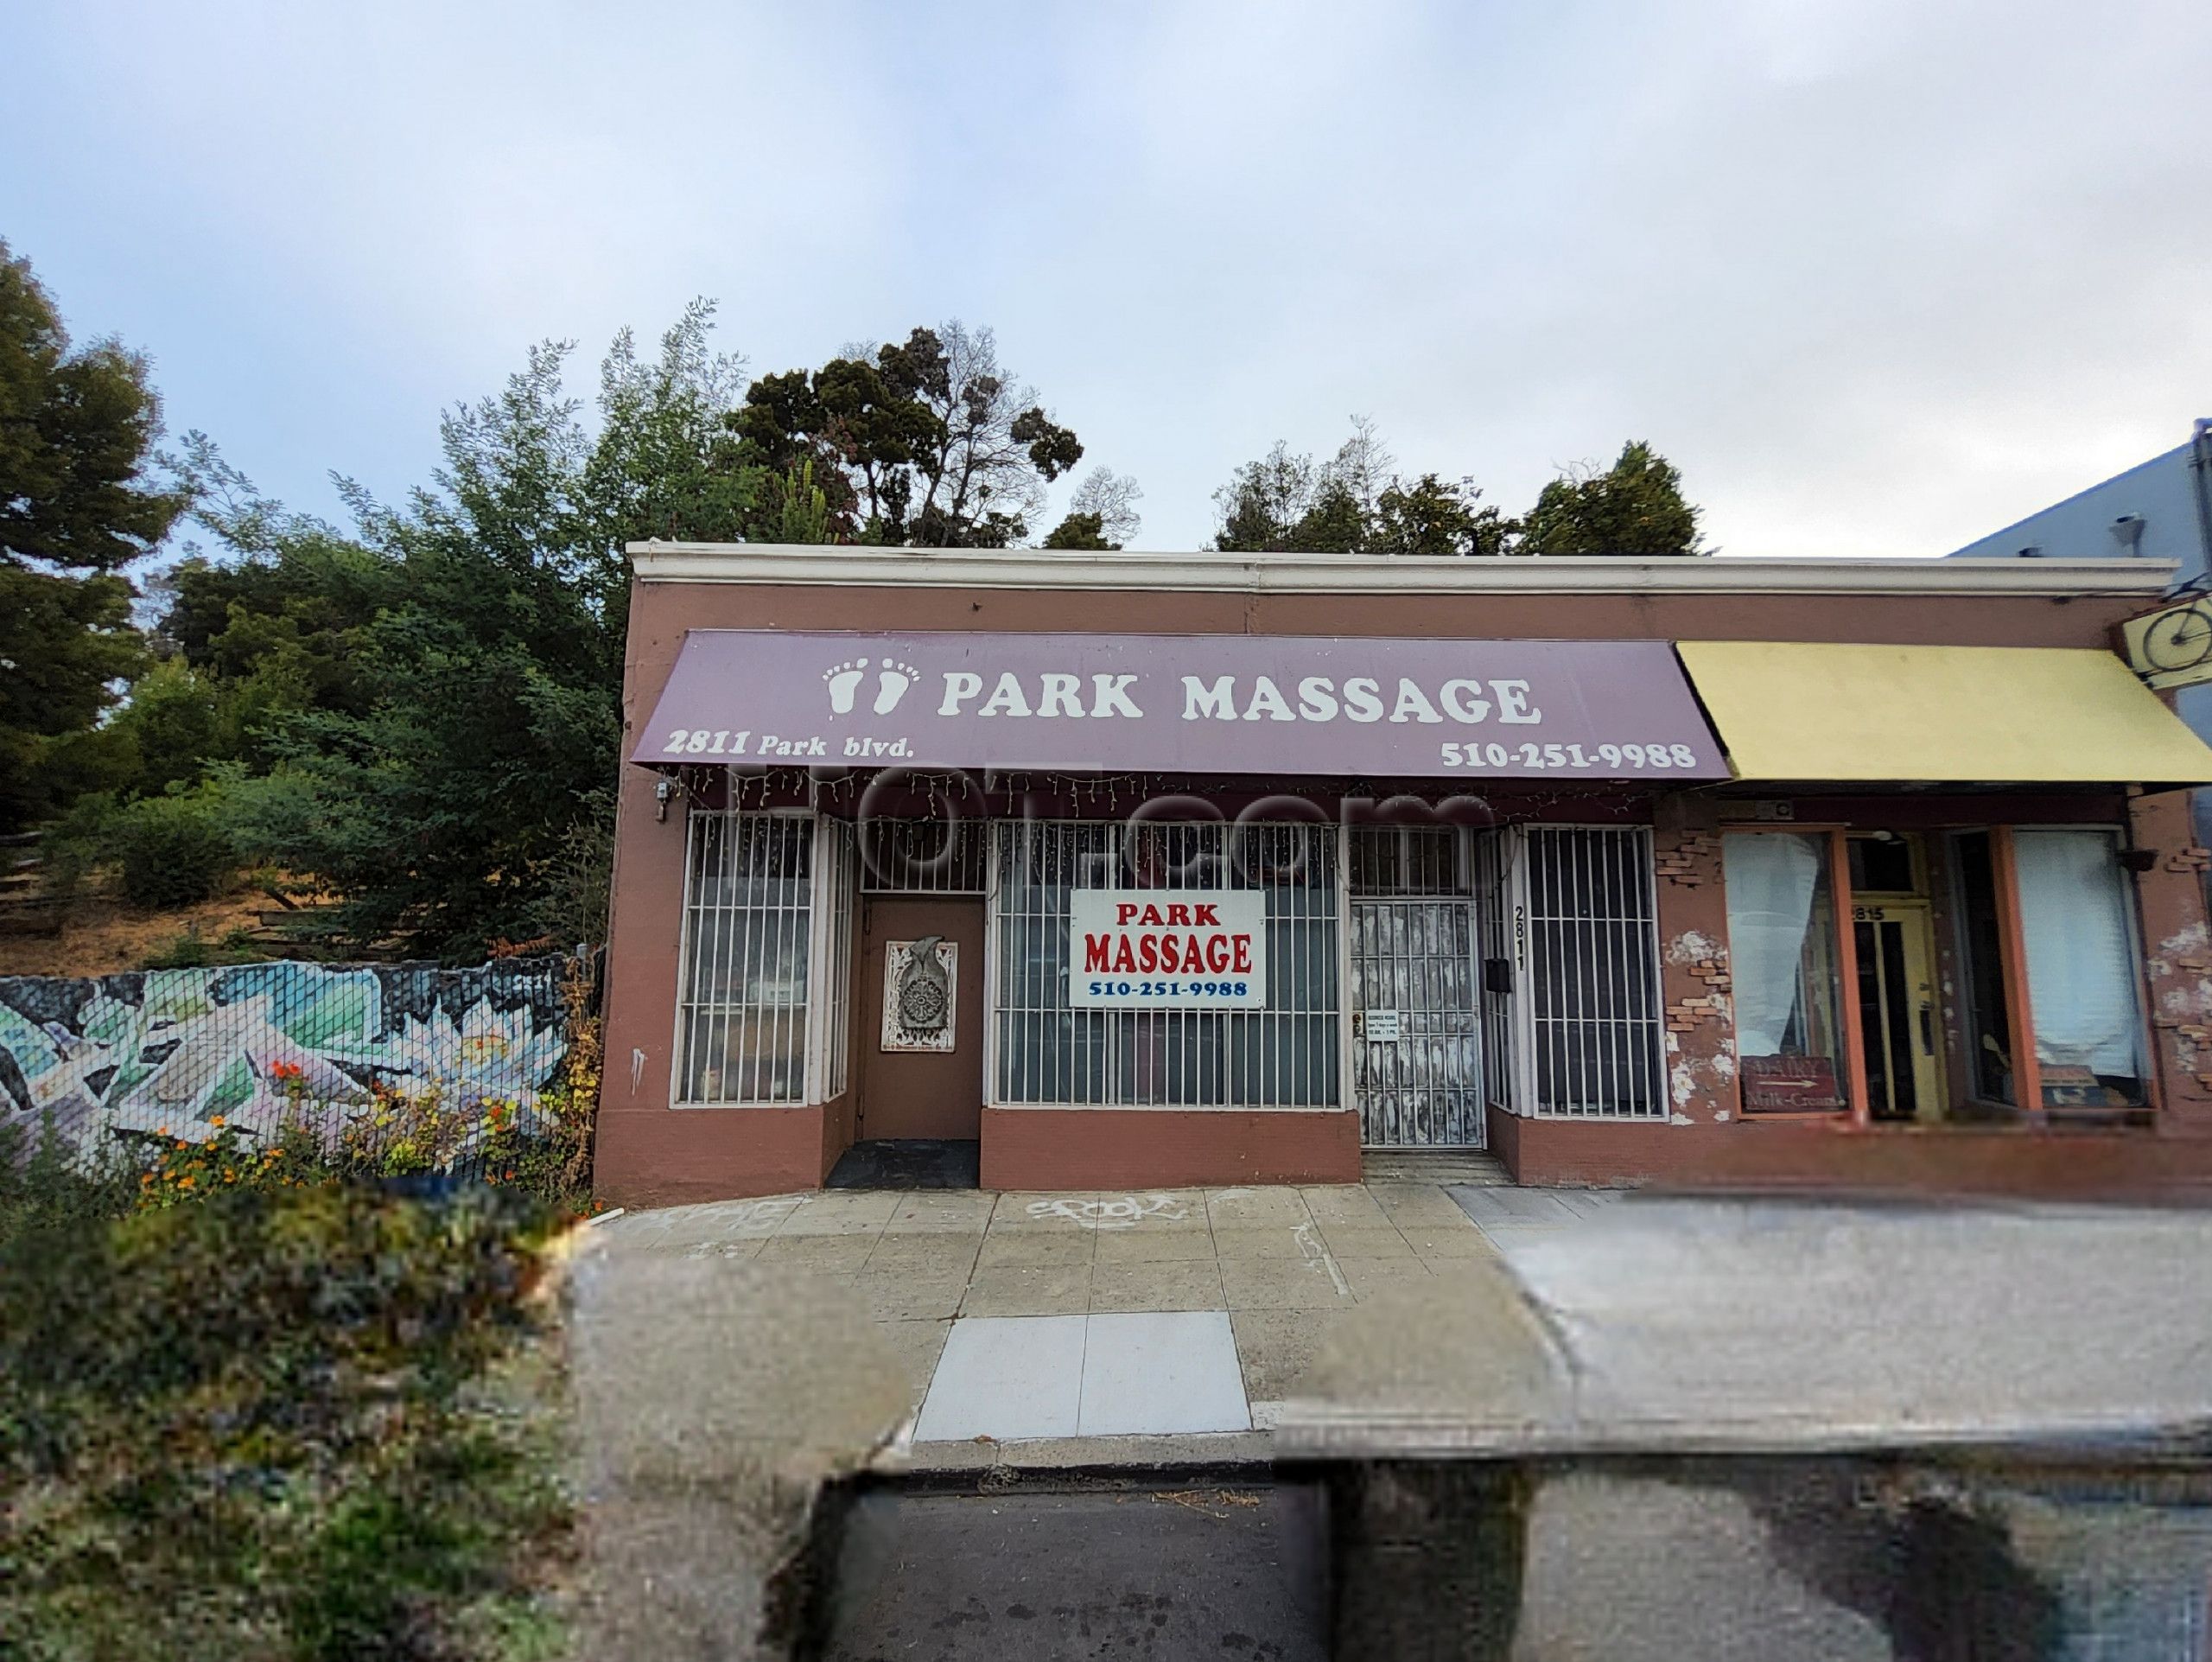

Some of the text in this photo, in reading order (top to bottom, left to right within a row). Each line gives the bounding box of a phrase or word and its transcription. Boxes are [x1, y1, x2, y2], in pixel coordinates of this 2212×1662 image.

[937, 672, 1541, 724] PARK MASSAGE
[663, 729, 914, 758] 2811 Park blvd.
[1441, 742, 1697, 769] 510-251-9988
[1116, 903, 1221, 927] PARK
[1515, 905, 1524, 971] 2811
[1084, 933, 1252, 974] MASSAGE
[1089, 981, 1248, 997] 510-251-9988
